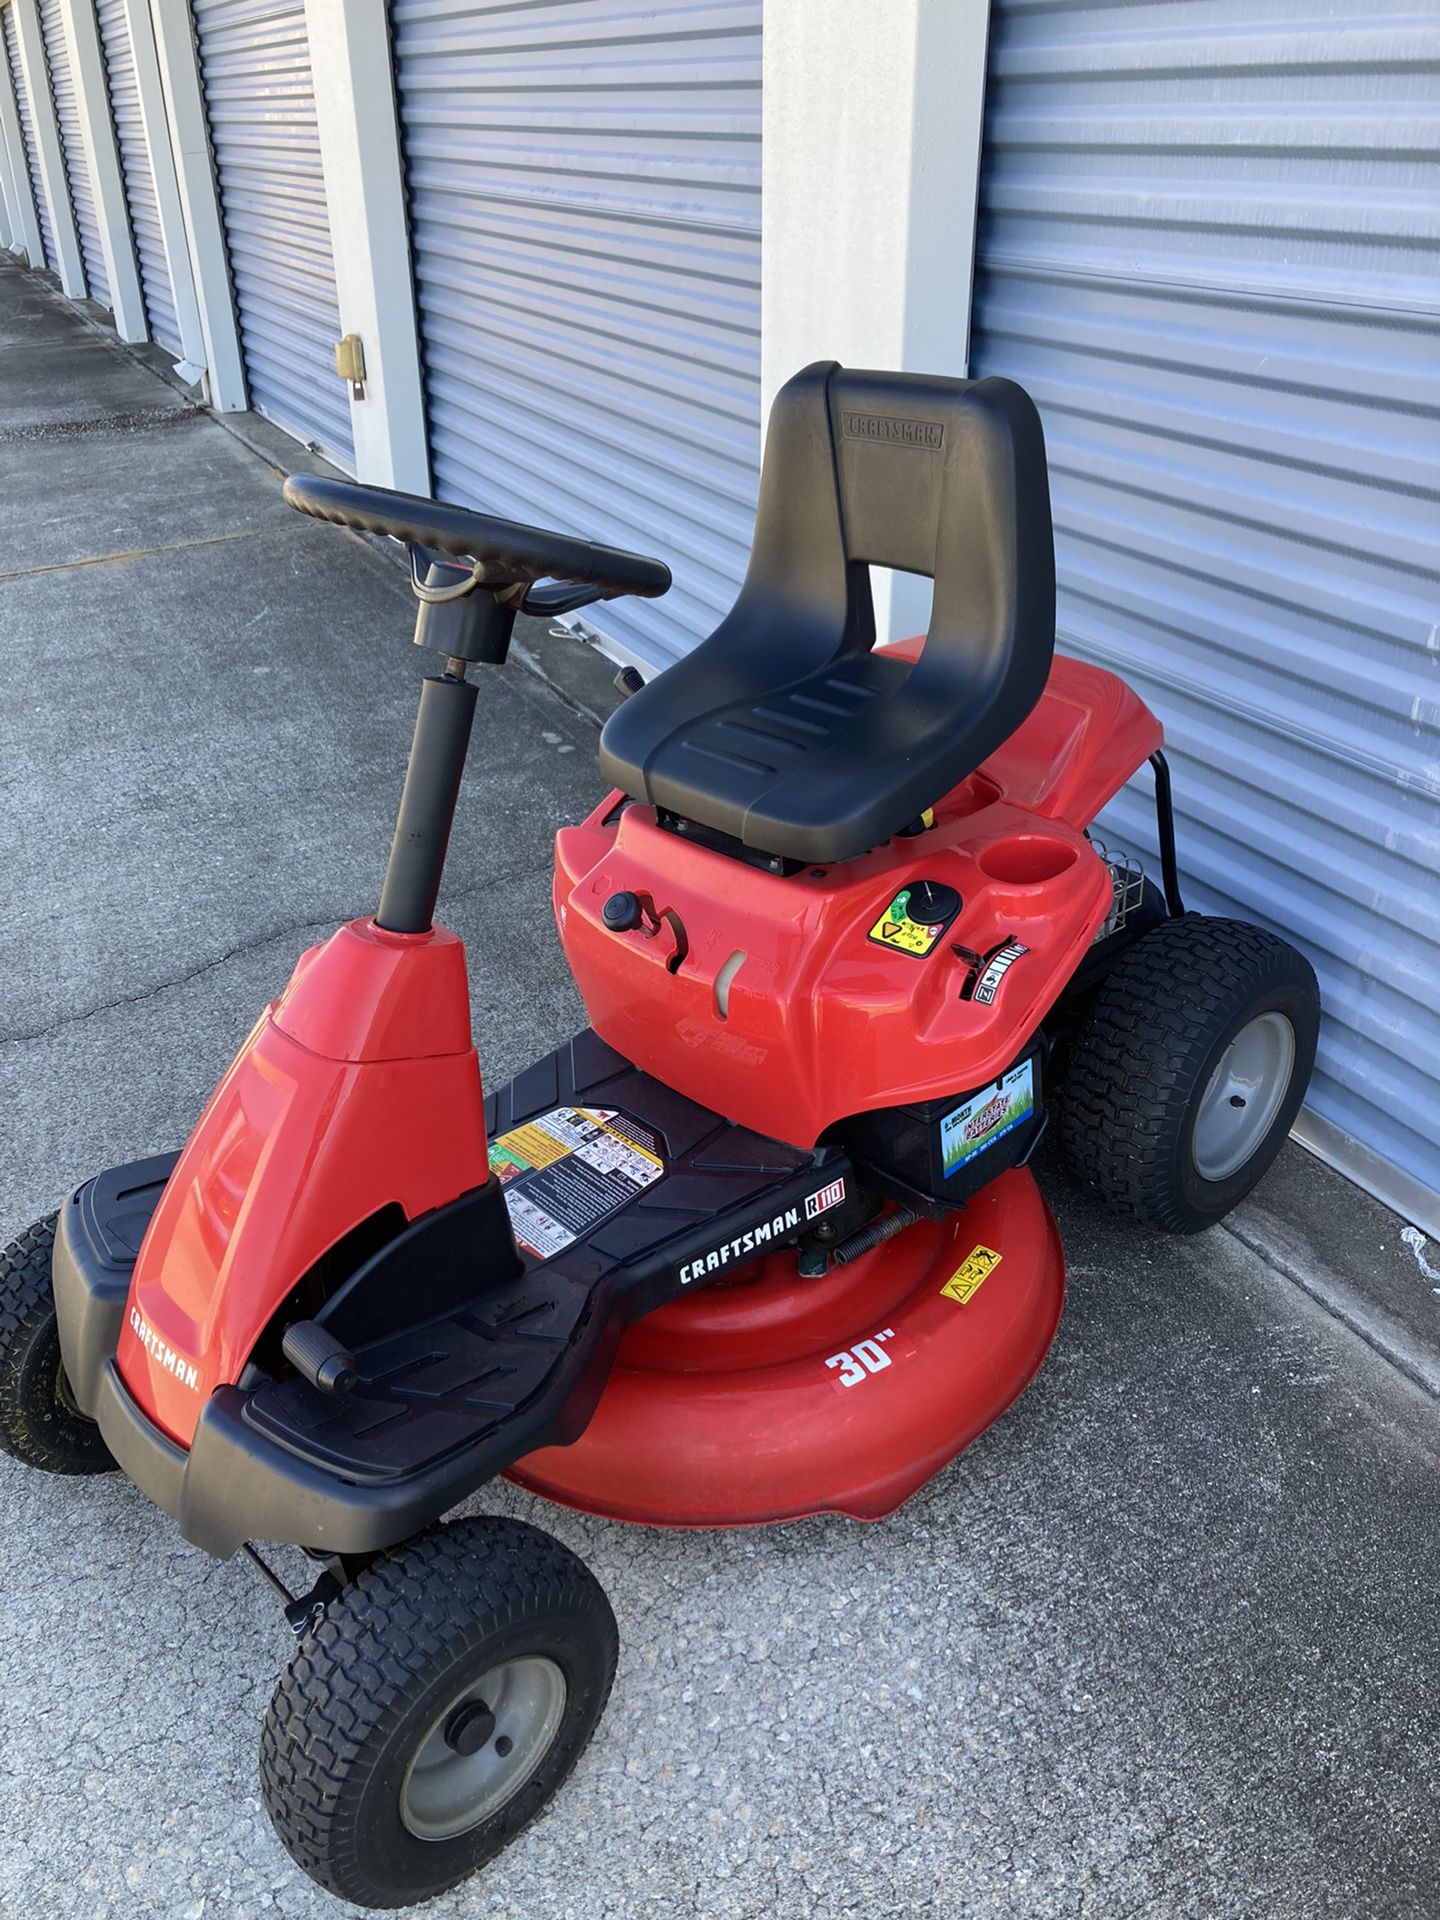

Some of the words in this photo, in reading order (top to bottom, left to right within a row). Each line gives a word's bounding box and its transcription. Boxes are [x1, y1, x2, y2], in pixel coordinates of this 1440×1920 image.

[848, 416, 935, 443] CRAFTSMAN
[964, 1096, 1010, 1130] INTERSTATE
[966, 1107, 1007, 1140] BATTERIES
[679, 1207, 799, 1284] CRAFTSMAN
[807, 1183, 841, 1216] R110
[129, 1306, 198, 1390] CRAFTSMAN
[824, 1328, 895, 1388] 30"
